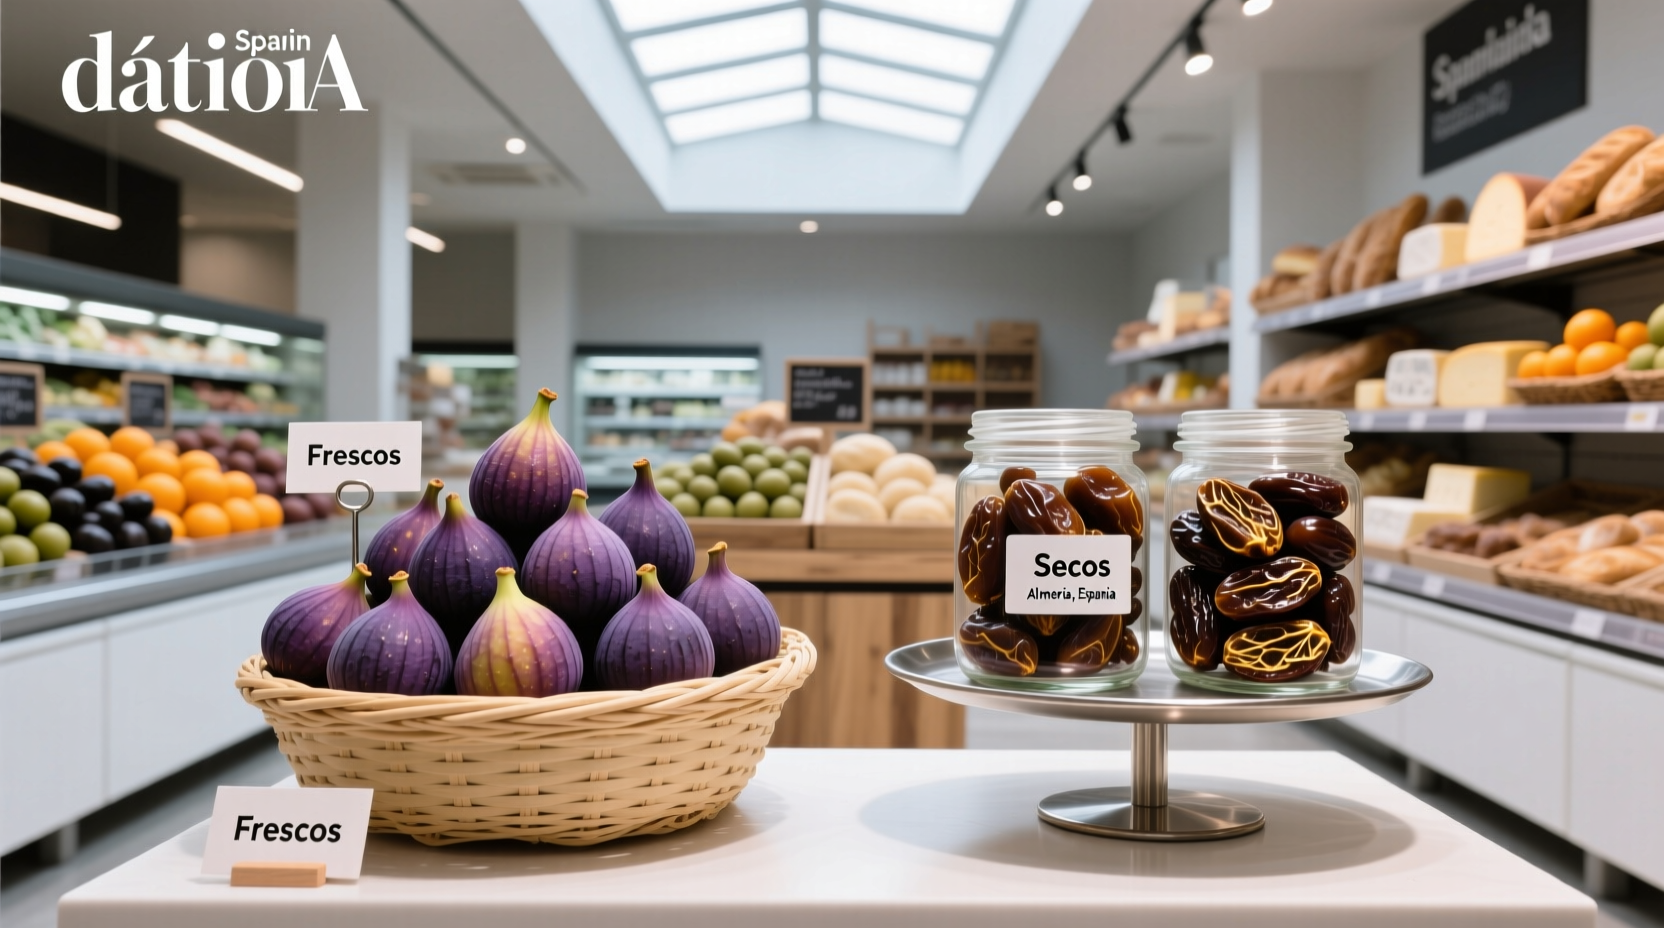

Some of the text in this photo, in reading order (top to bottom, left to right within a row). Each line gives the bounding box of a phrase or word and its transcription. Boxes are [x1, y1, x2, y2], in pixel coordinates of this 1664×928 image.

[307, 444, 401, 466] Frescos
[1034, 553, 1111, 577] Secos
[234, 815, 342, 843] Frescos
